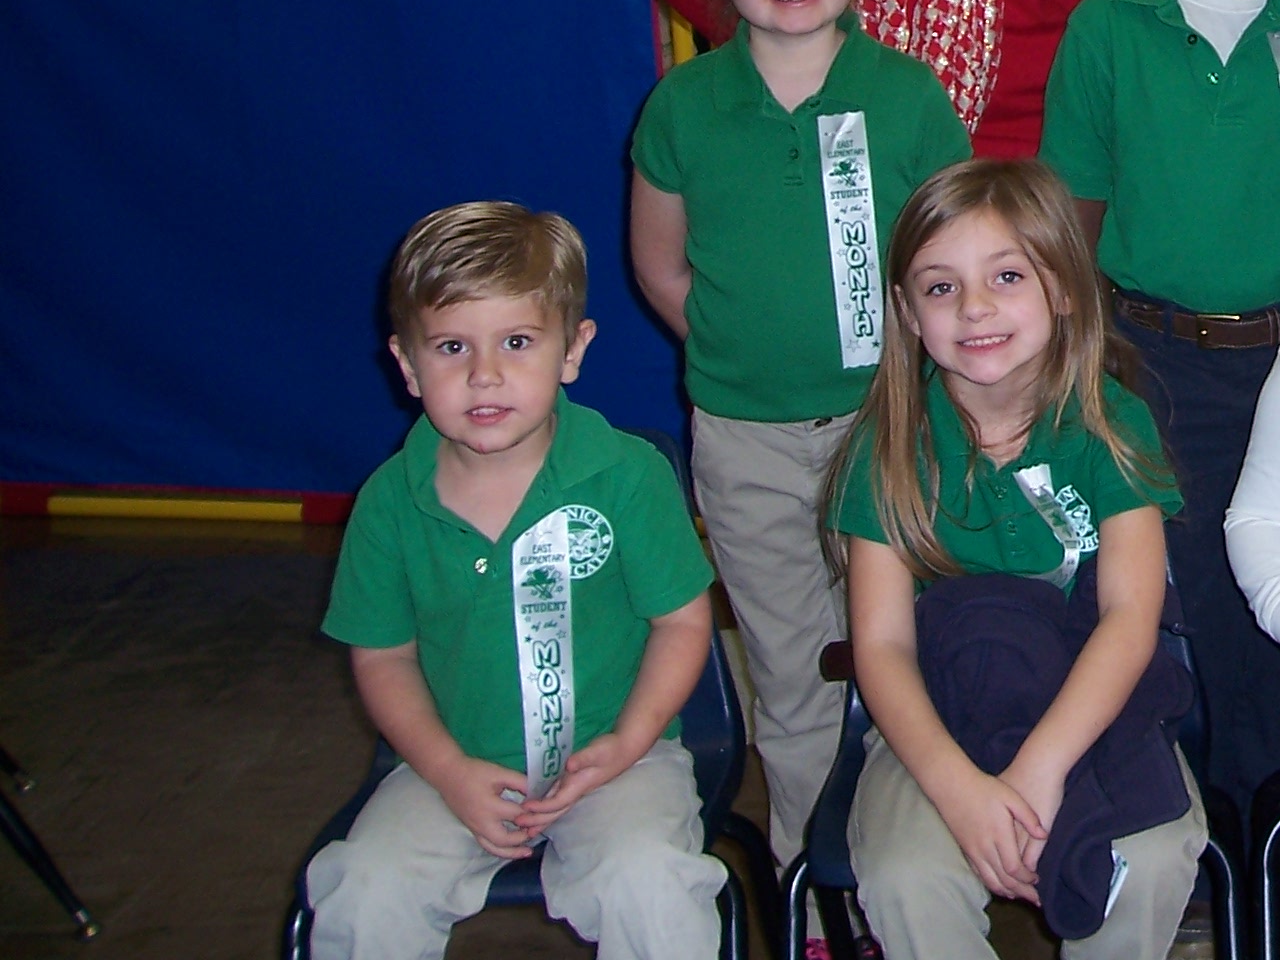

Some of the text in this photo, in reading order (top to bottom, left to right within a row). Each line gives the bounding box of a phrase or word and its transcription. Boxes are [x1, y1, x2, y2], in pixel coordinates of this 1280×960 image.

[837, 139, 853, 149] EAST
[827, 147, 865, 159] ELEMENTARY
[830, 188, 868, 200] STUDENT
[841, 220, 873, 337] MONTH
[566, 507, 604, 525] NICE
[532, 543, 552, 554] EAST
[520, 552, 565, 565] ELEMENTARY
[521, 601, 567, 615] STUDENT
[532, 639, 561, 779] MONTH
